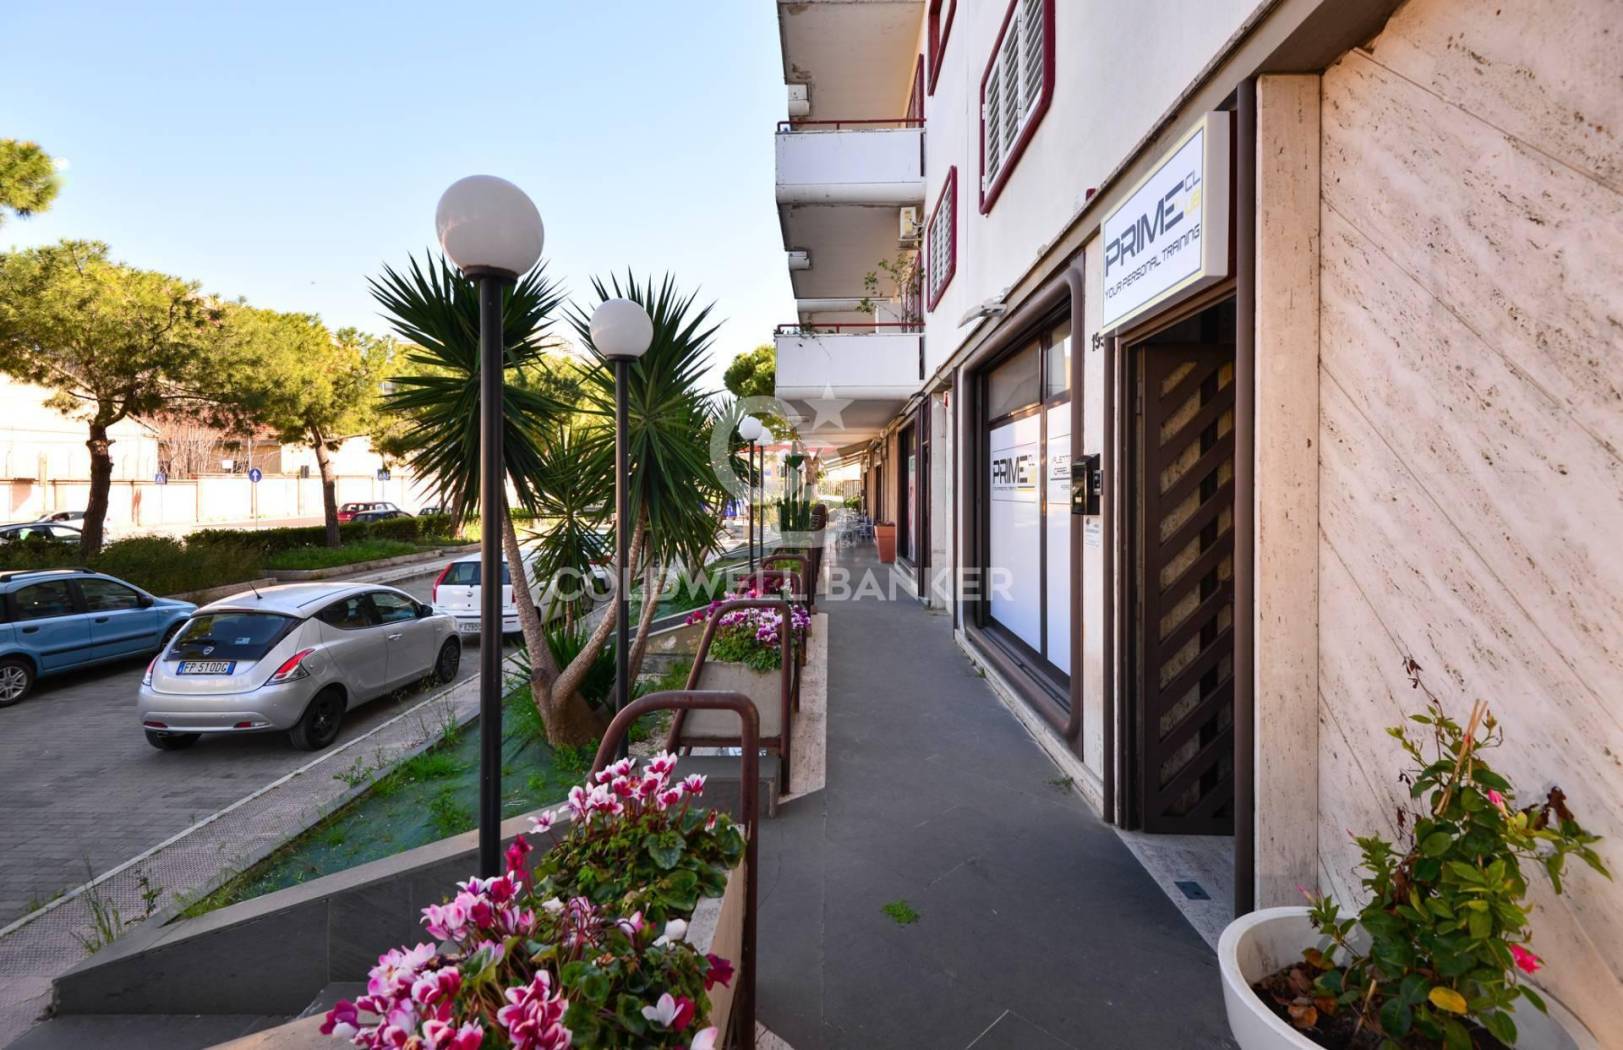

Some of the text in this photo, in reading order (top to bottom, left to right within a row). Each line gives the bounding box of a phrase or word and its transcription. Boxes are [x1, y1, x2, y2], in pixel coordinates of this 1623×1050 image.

[1105, 180, 1184, 277] PRIME
[1105, 223, 1200, 299] YOUR PERSONAL TRAINING
[992, 455, 1028, 484] PRIME
